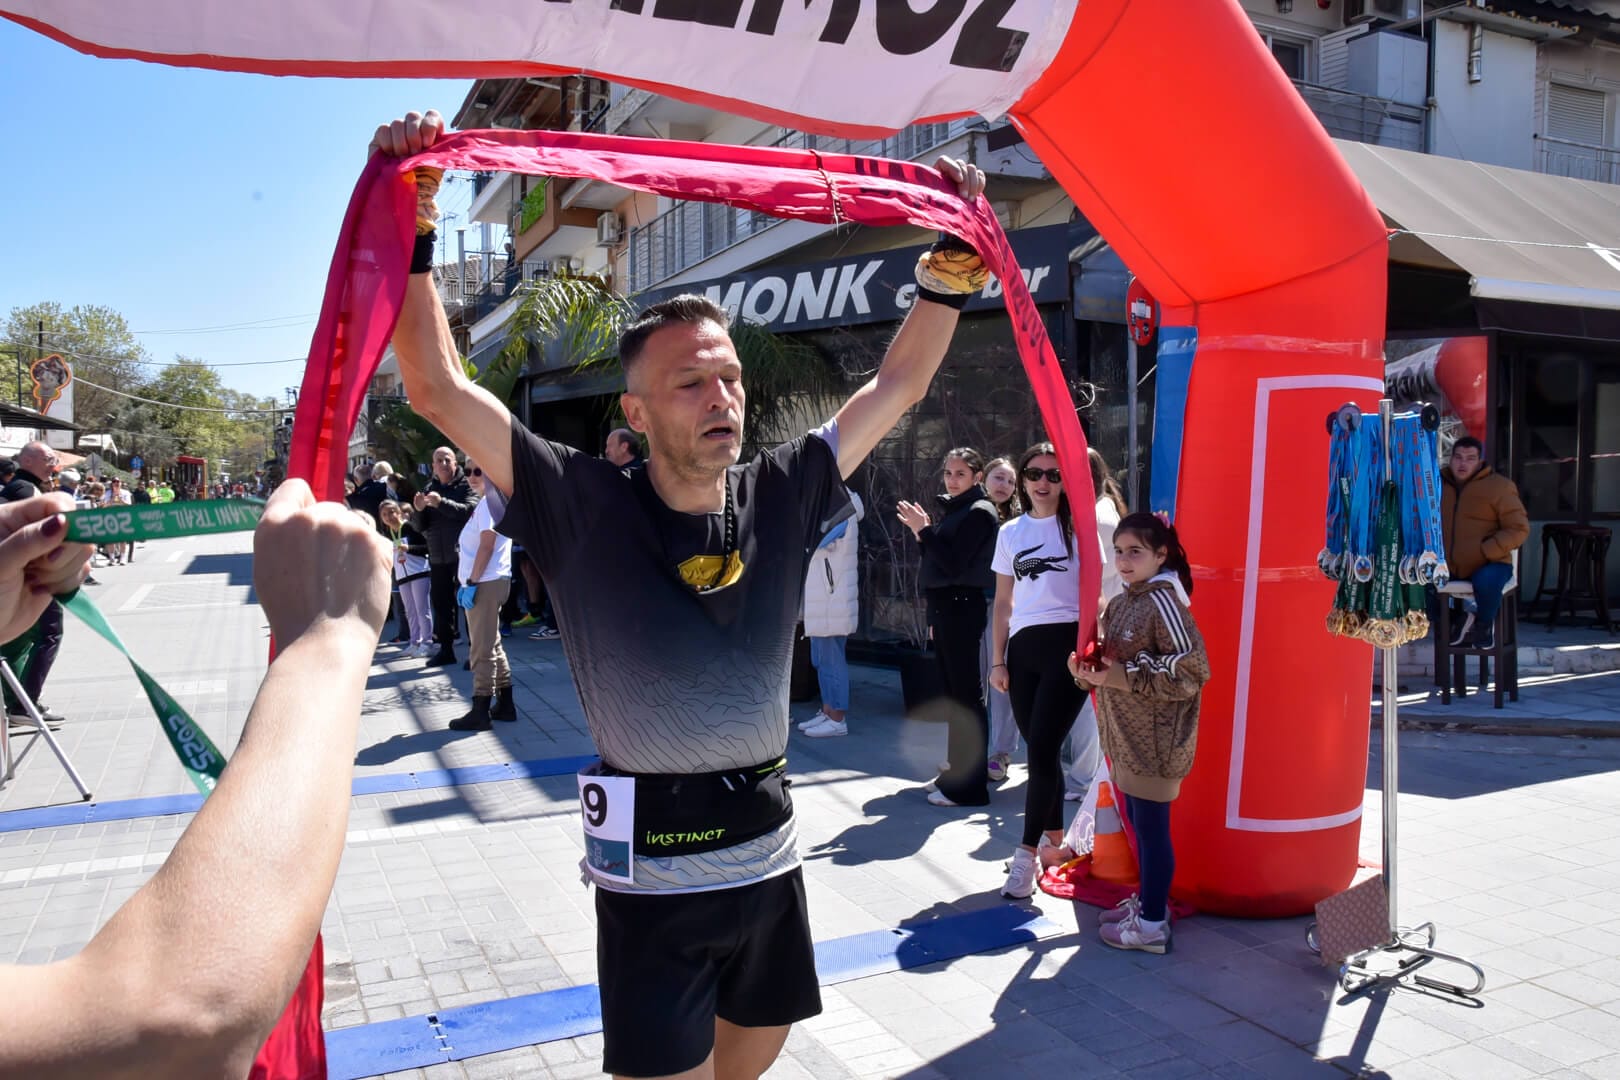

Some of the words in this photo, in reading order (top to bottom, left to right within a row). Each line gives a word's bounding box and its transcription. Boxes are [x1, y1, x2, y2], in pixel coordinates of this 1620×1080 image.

[704, 260, 884, 327] MONK
[75, 512, 136, 538] 2025
[169, 506, 216, 530] TRAIL
[167, 713, 216, 771] 2025
